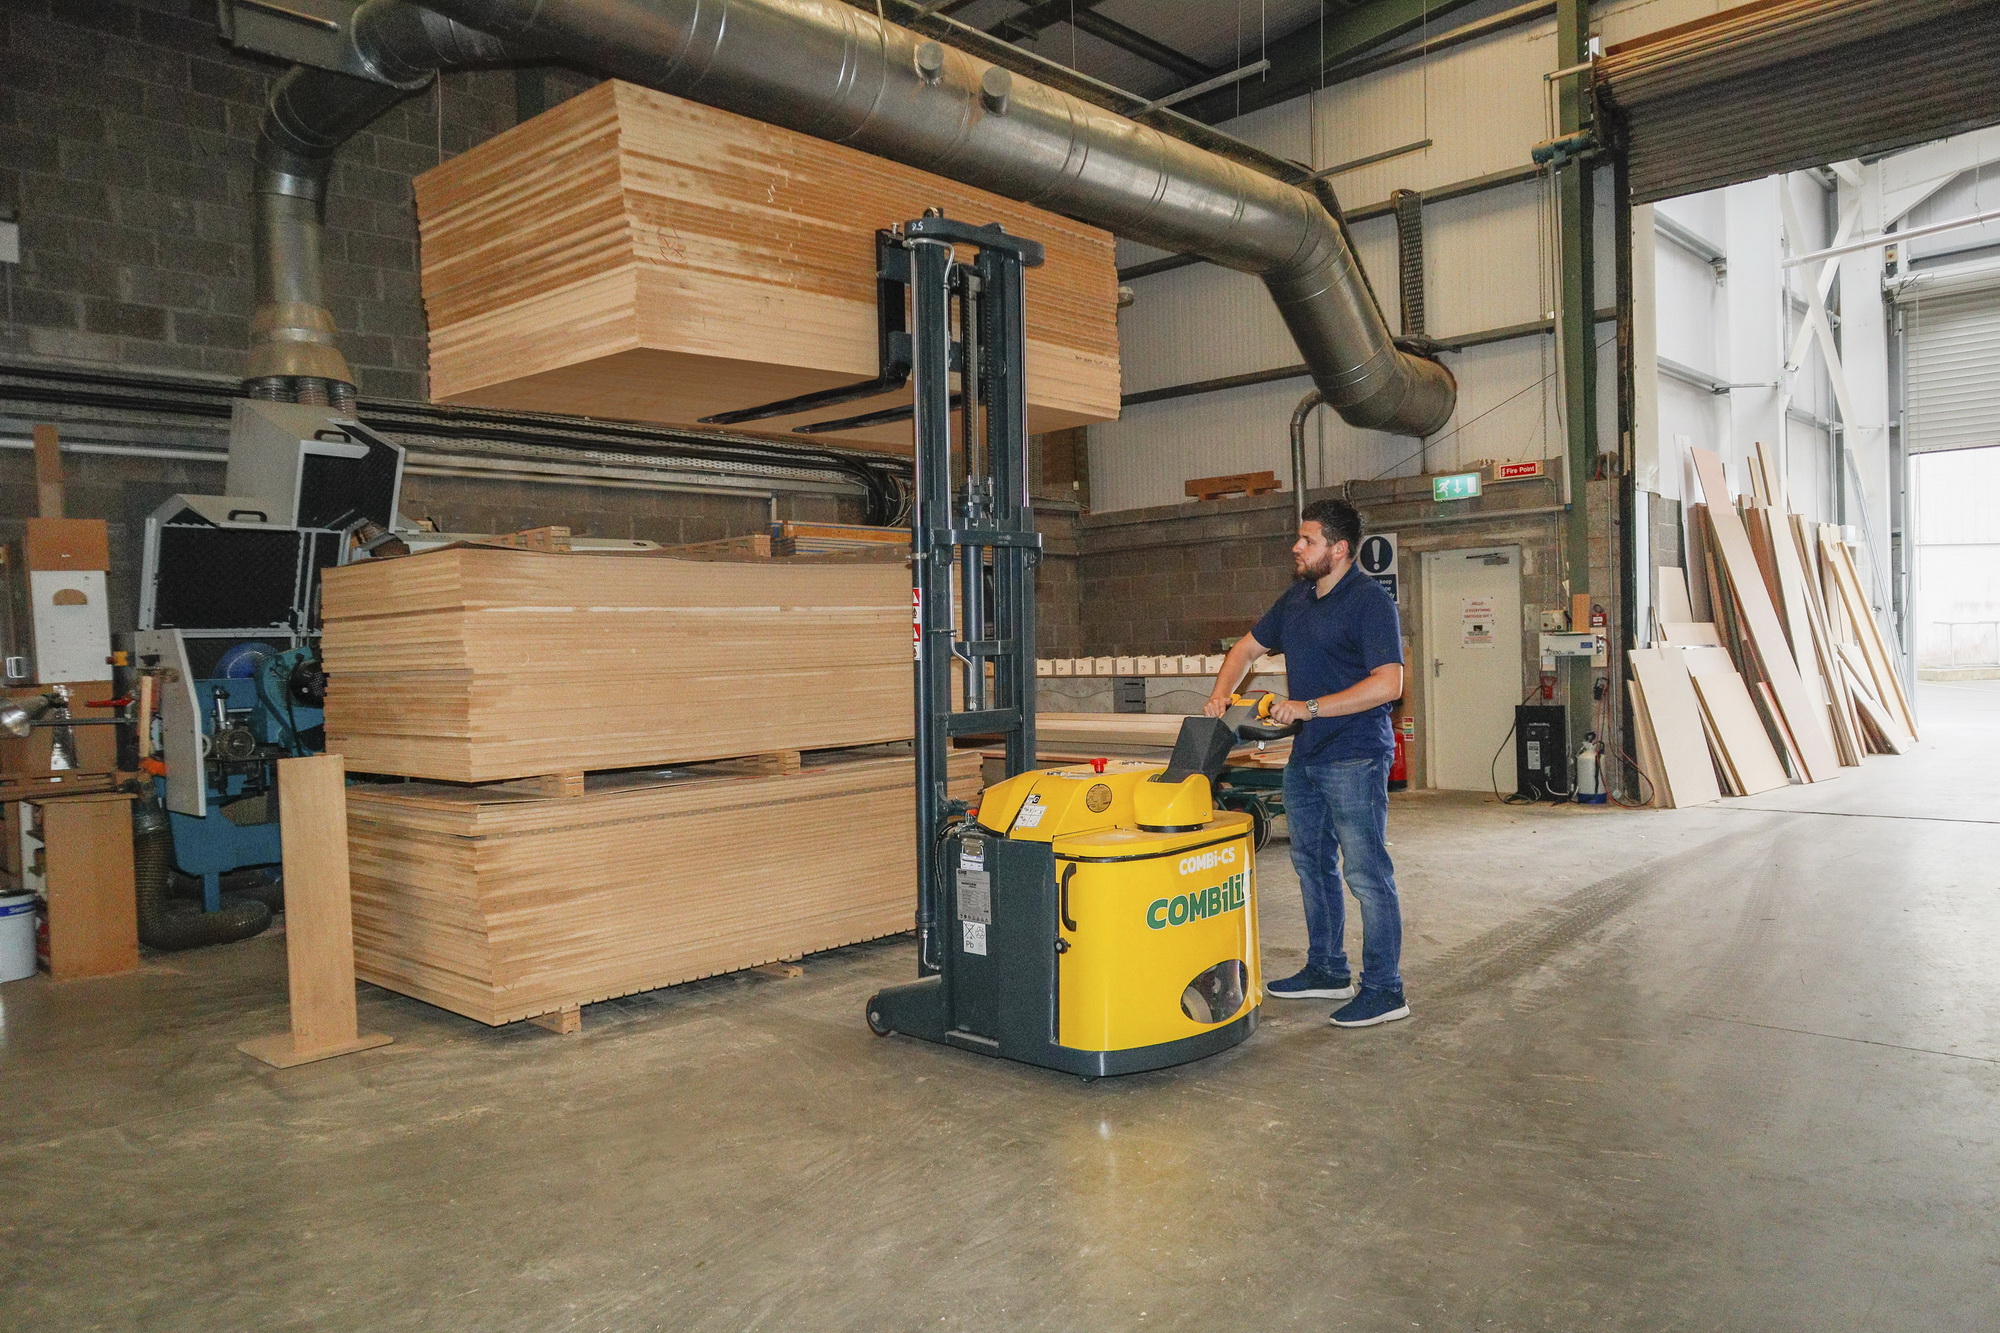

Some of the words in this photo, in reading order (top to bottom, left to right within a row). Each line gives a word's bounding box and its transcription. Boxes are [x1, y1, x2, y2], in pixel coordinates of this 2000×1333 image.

[1519, 465, 1535, 473] Point
[1146, 867, 1253, 930] COMBiLi
[966, 941, 974, 949] Pb
